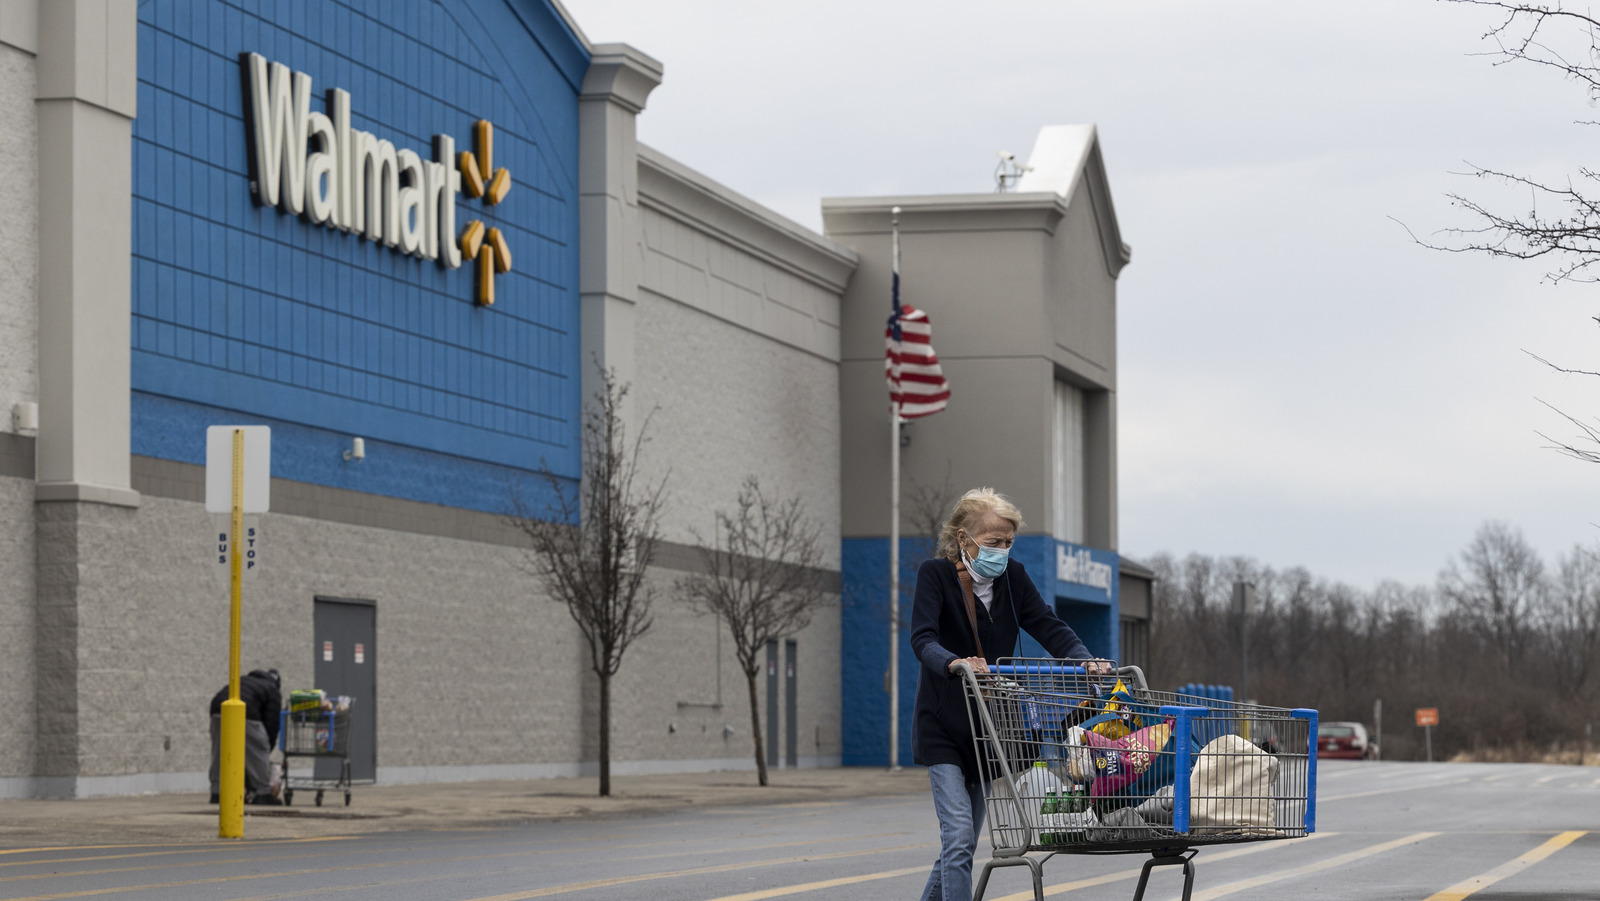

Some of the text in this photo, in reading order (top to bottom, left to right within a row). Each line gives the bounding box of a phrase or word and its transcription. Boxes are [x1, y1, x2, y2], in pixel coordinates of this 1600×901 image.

[243, 52, 461, 270] Walmart
[218, 533, 227, 564] BUS
[246, 527, 256, 570] STOP
